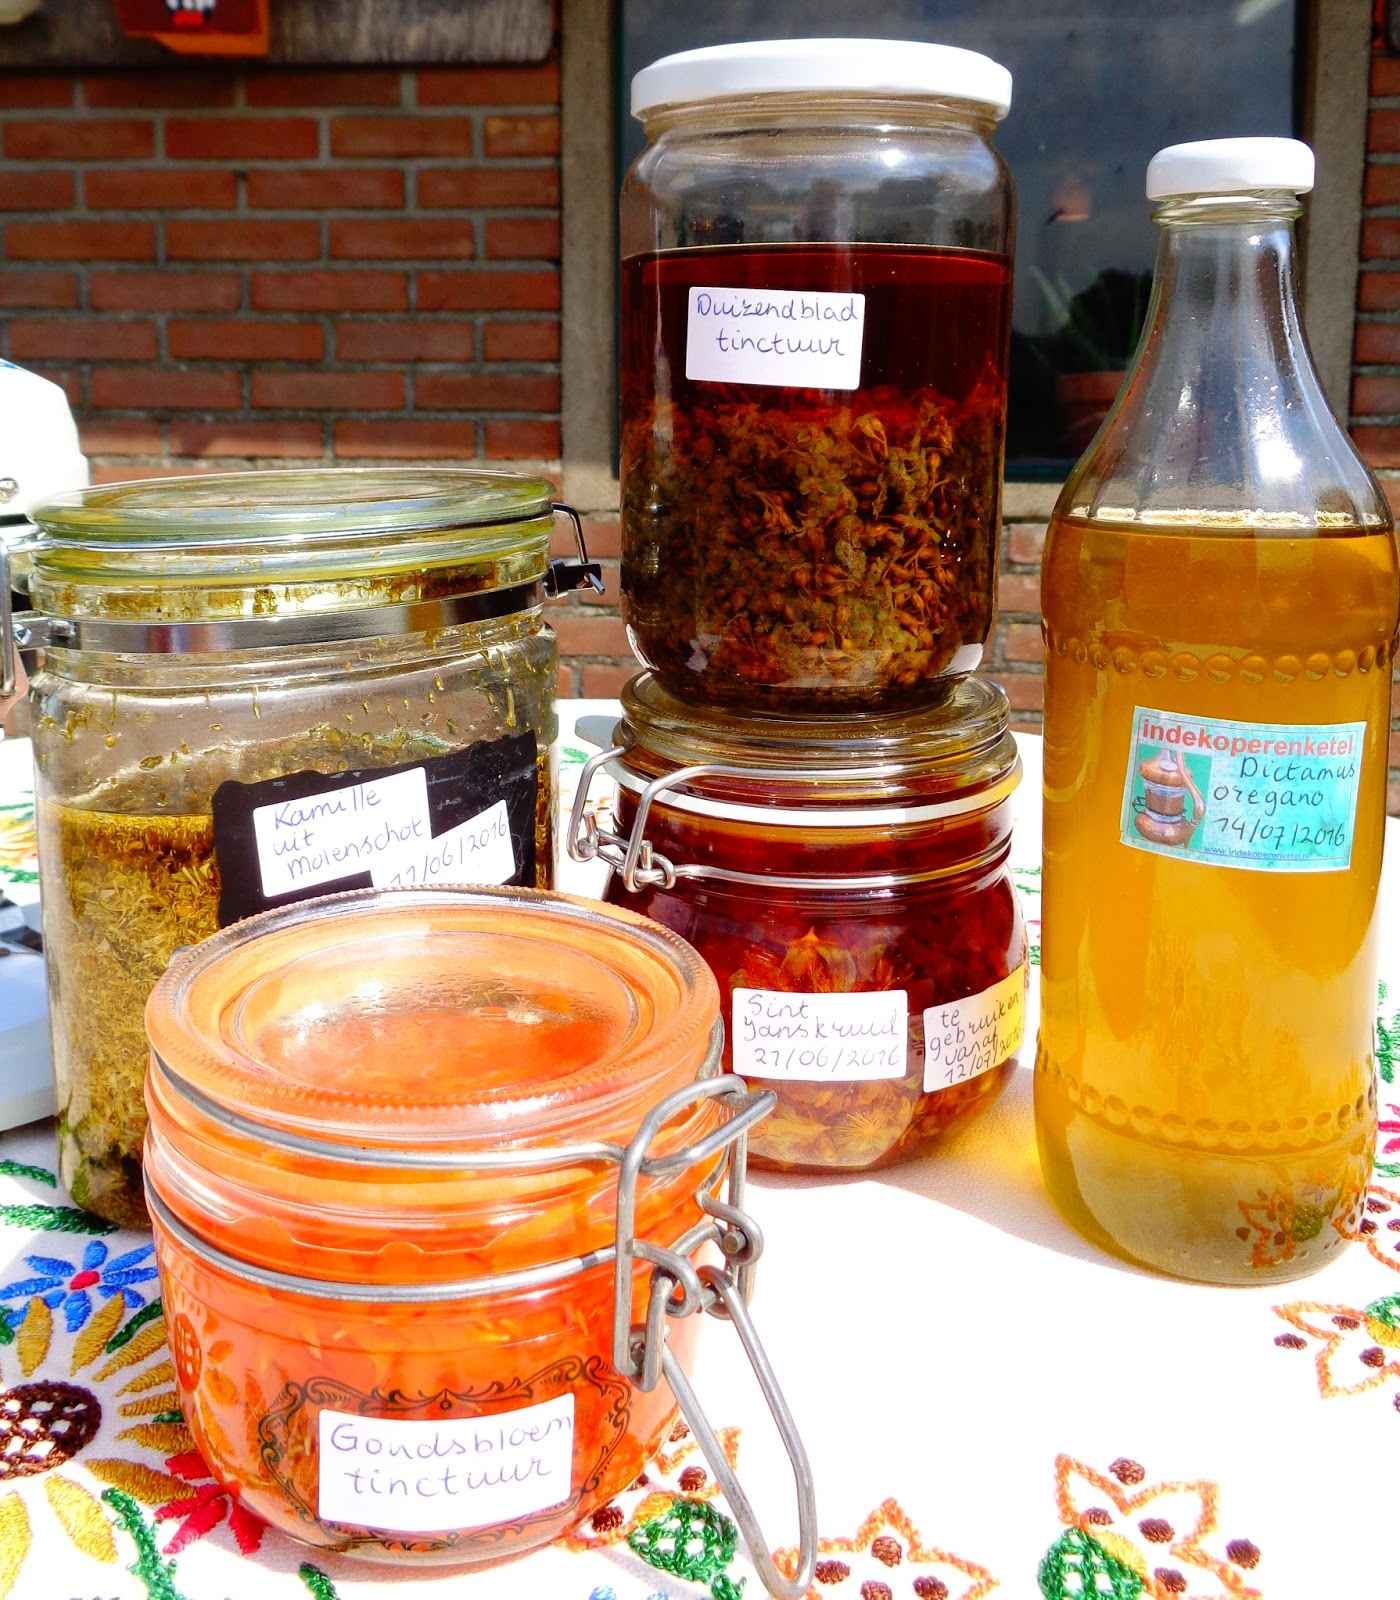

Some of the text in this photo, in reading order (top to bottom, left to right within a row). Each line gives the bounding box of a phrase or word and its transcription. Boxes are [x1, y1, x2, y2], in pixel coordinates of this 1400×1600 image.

[697, 293, 858, 321] Duizendblad
[716, 328, 845, 356] tinctuur
[1142, 719, 1354, 757] indekoperenketel
[1240, 756, 1355, 781] Dictamus
[275, 784, 381, 830] Kamille
[1213, 785, 1324, 816] oregano
[273, 830, 314, 856] uit
[1204, 845, 1309, 860] www.indekoperenketel.nl
[747, 994, 809, 1019] Sint
[941, 1009, 961, 1028] te
[930, 992, 1019, 1061] gebruiken
[344, 1455, 552, 1496] tinctuur
